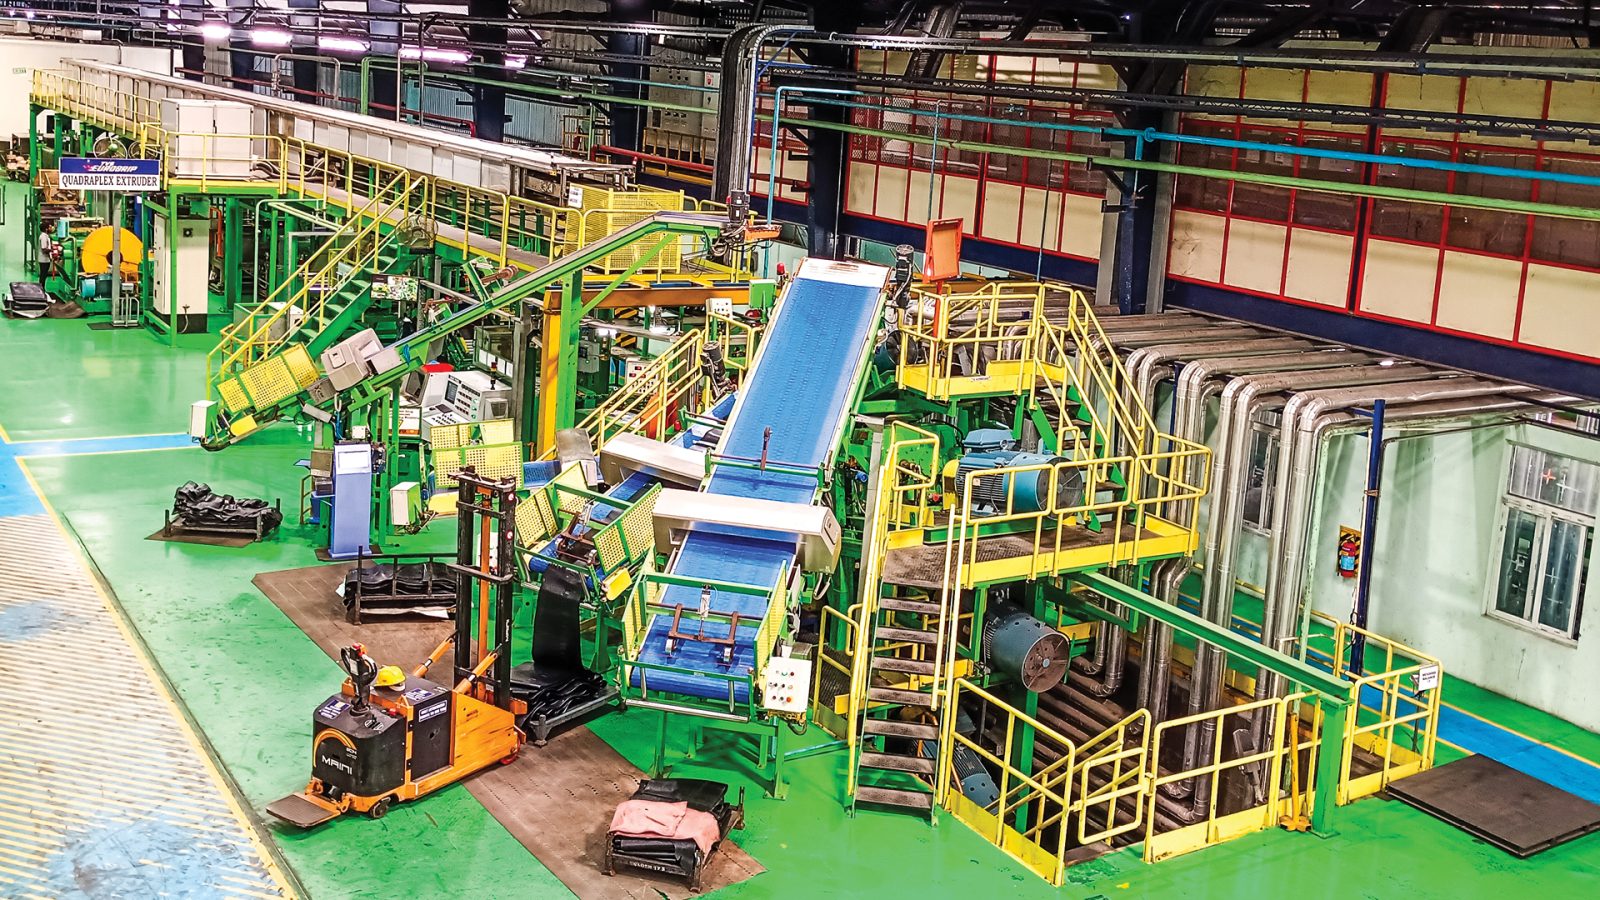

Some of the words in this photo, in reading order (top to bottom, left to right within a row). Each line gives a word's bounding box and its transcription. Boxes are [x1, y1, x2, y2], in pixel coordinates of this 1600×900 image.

[89, 164, 138, 172] EUROGRIP
[62, 175, 114, 187] QUADRAPLEX
[116, 176, 157, 186] EXTRUDER
[321, 755, 353, 775] MAINI
